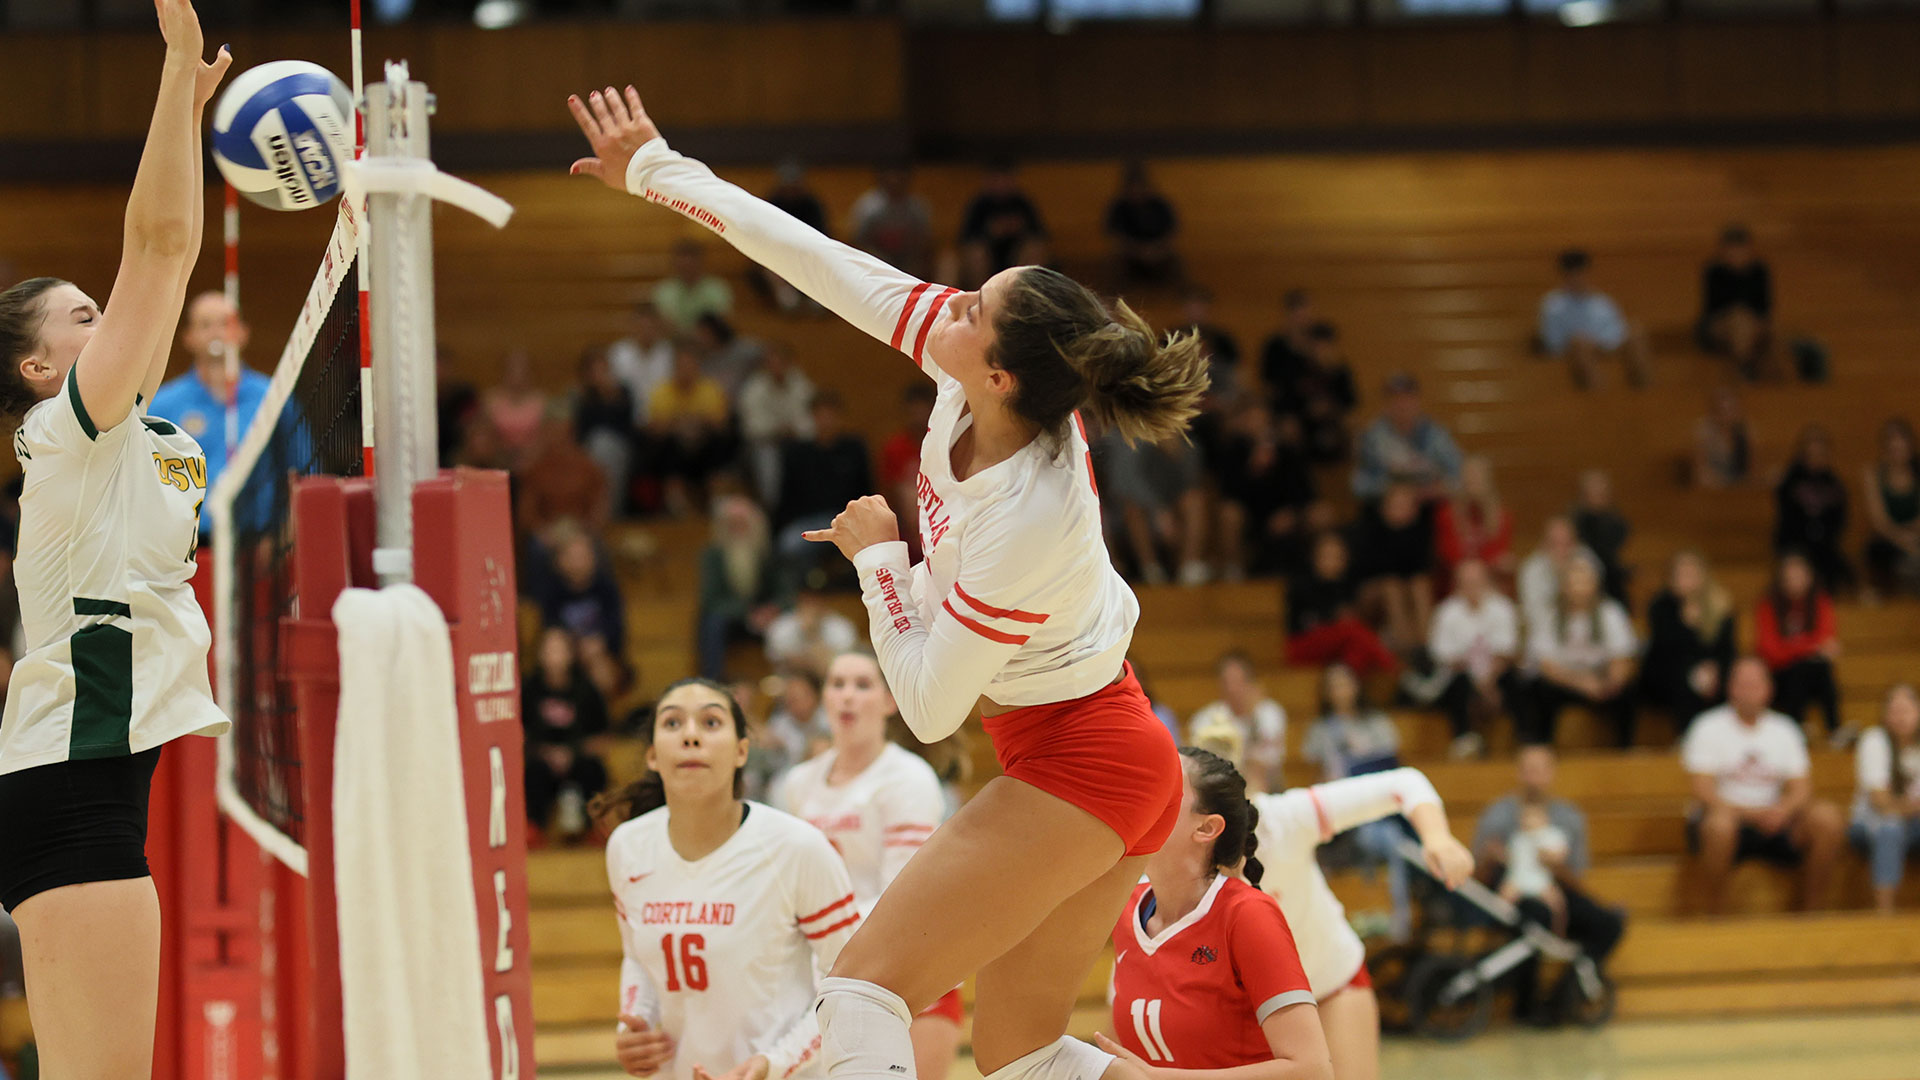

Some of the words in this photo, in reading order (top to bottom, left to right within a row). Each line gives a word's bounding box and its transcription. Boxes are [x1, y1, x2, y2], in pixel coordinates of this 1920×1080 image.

[269, 135, 310, 203] molten
[294, 131, 338, 190] NCAA
[671, 199, 727, 233] DRAGONS
[876, 568, 903, 616] DRAGONS
[642, 902, 735, 926] CORTLAND
[662, 933, 708, 992] 16
[1130, 998, 1175, 1062] 11
